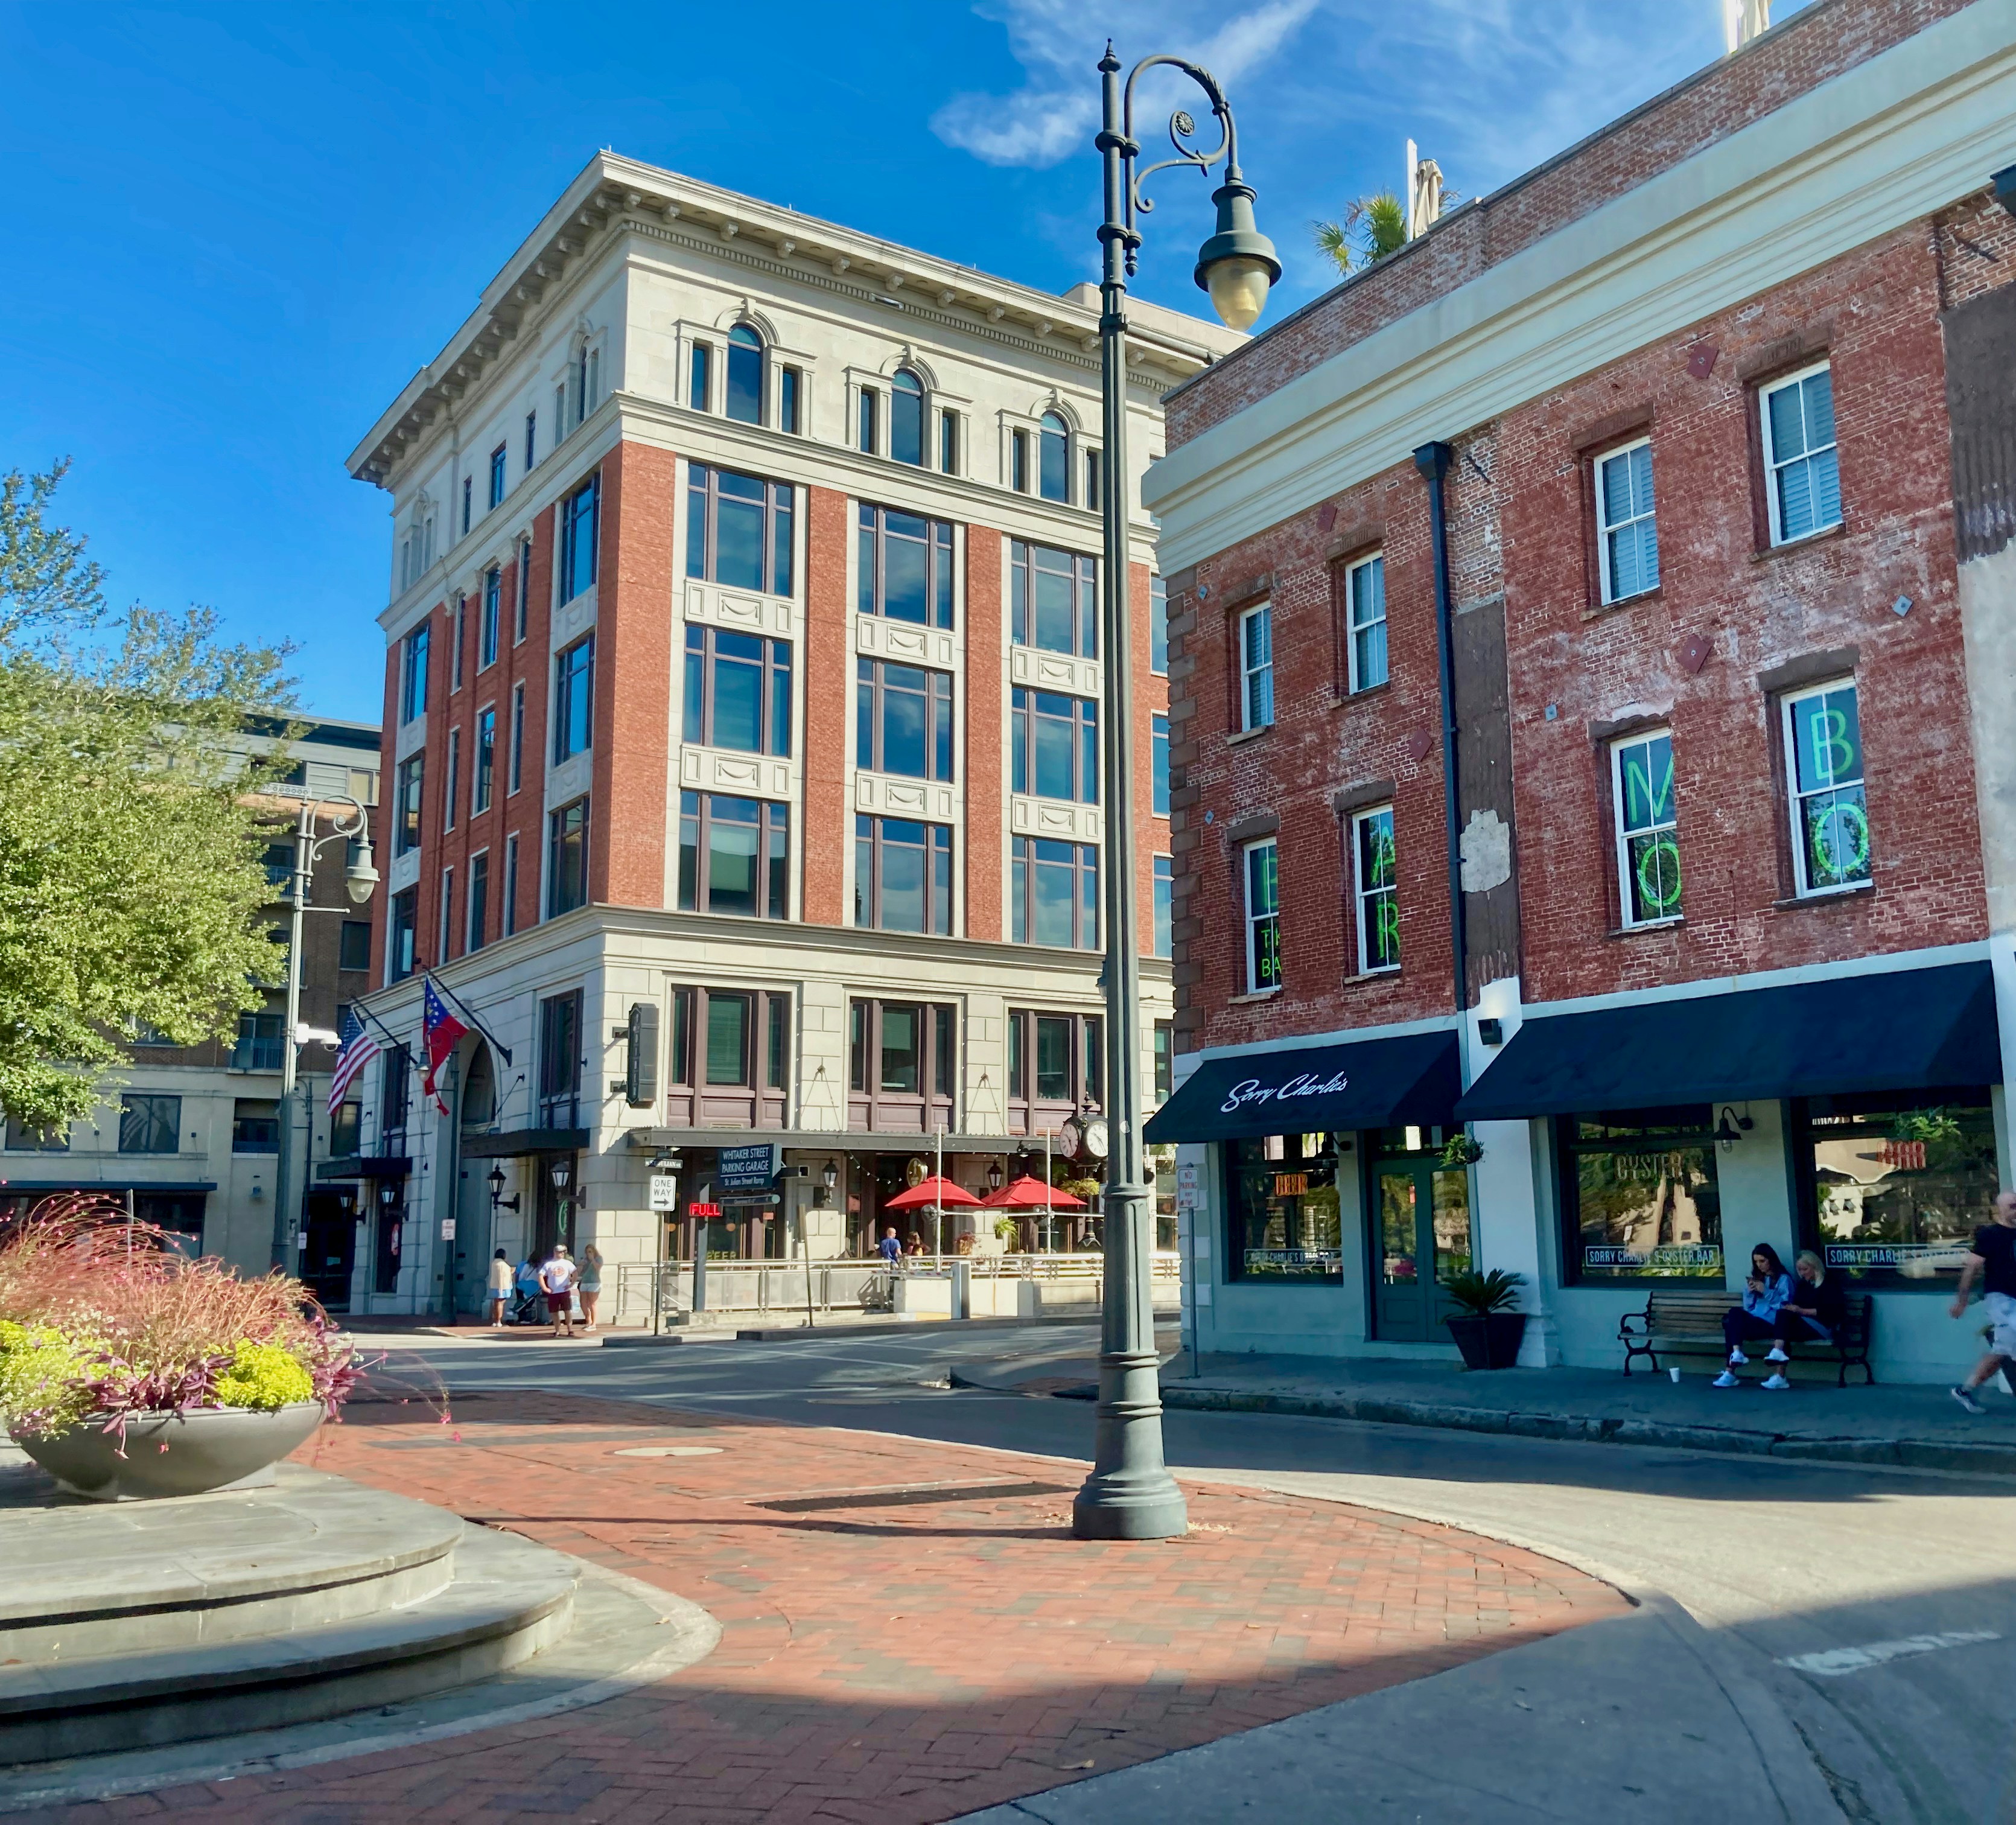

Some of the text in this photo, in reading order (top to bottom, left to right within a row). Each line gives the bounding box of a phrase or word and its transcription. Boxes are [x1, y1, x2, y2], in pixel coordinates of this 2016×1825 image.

[1810, 709, 1854, 780] B
[1377, 803, 1869, 958] R O O
[1261, 927, 1280, 948] TK
[1220, 1071, 1347, 1112] Sorry Charlie's
[722, 1147, 769, 1160] WHITAKER STREET
[1877, 1140, 1926, 1170] BAR
[722, 1160, 769, 1173] PARKING GARAGE
[1617, 1151, 1682, 1180] OYSTER
[1184, 1171, 1192, 1180] NO
[655, 1179, 672, 1188] ONE
[1275, 1174, 1308, 1196] BEER
[690, 1204, 720, 1215] FULL
[707, 1250, 736, 1260] BEER
[1589, 1250, 1615, 1263] SORRY
[1662, 1250, 1694, 1263] OYSTER
[1697, 1250, 1714, 1262] BAR
[1830, 1250, 1863, 1263] SORRY
